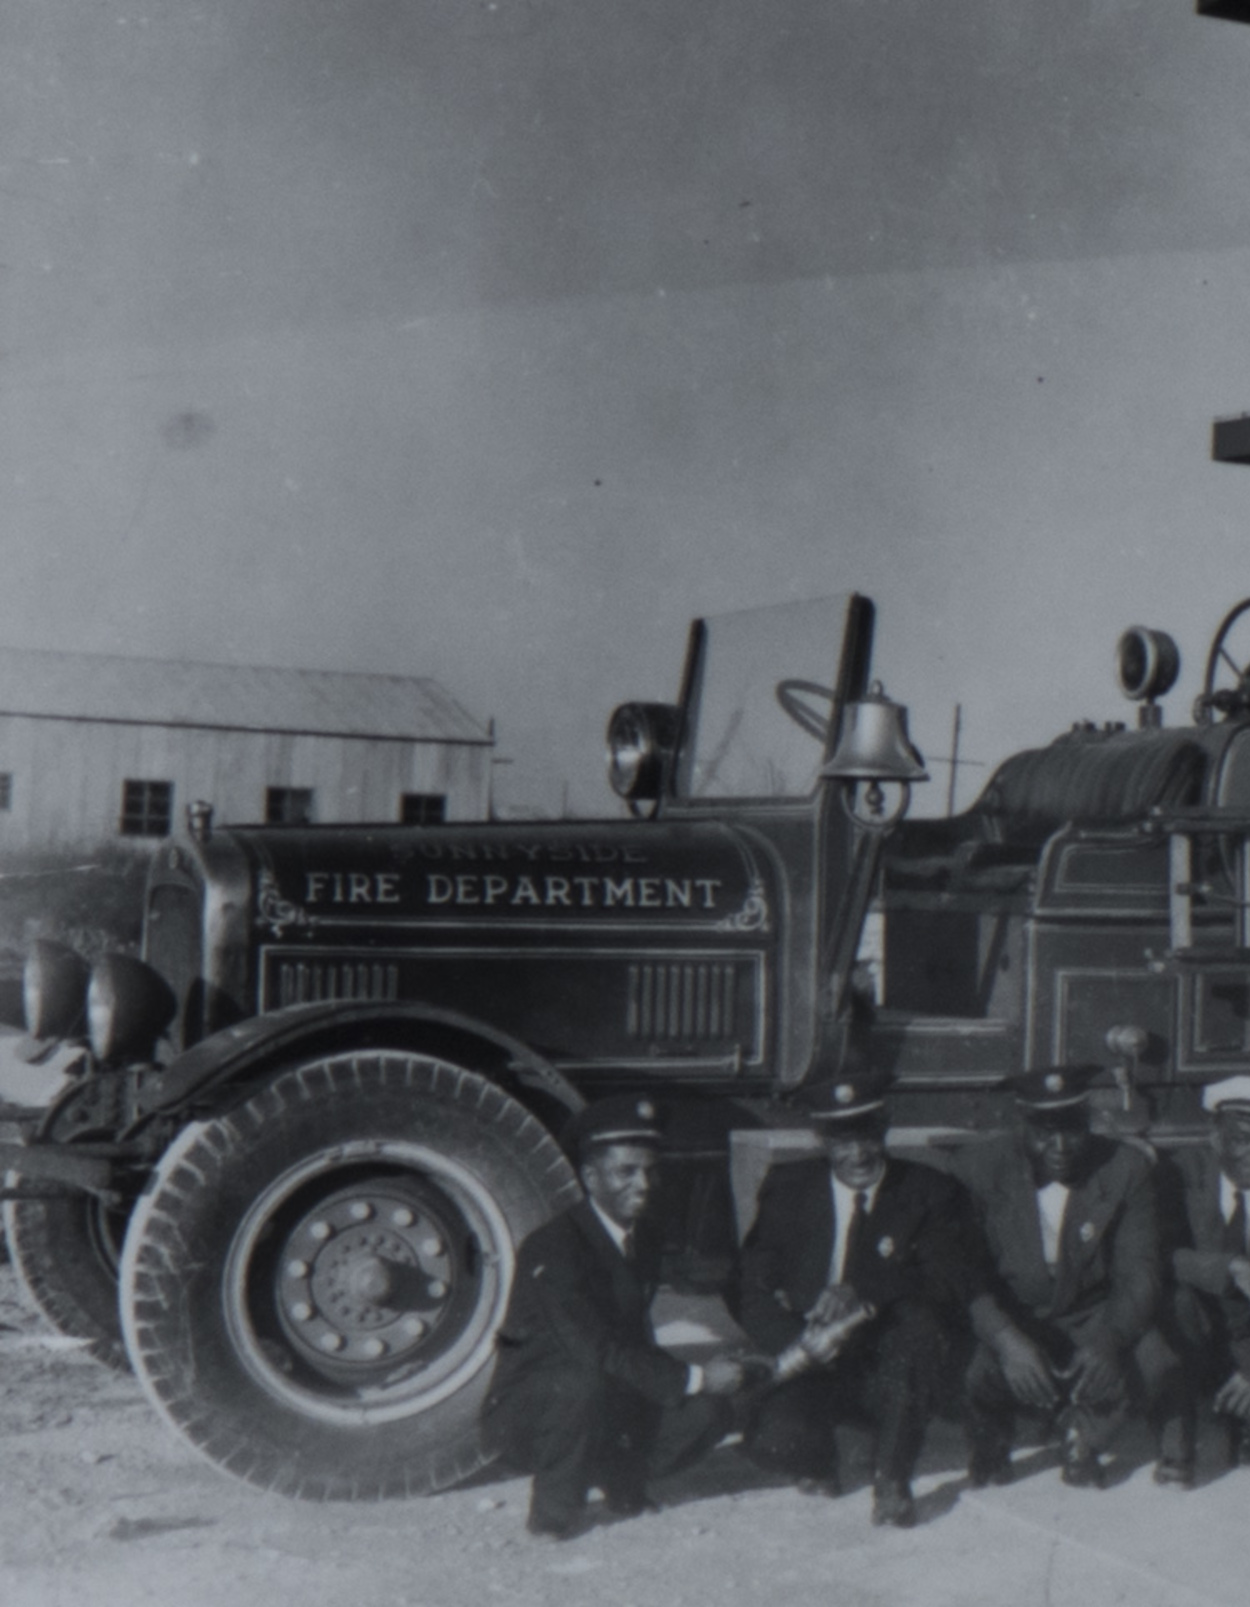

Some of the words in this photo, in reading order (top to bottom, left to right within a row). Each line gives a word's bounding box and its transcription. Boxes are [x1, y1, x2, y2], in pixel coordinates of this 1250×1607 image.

[389, 841, 649, 863] SUNNYSIDE
[304, 872, 402, 904] FIRE
[427, 873, 722, 908] DEPARTMENT
